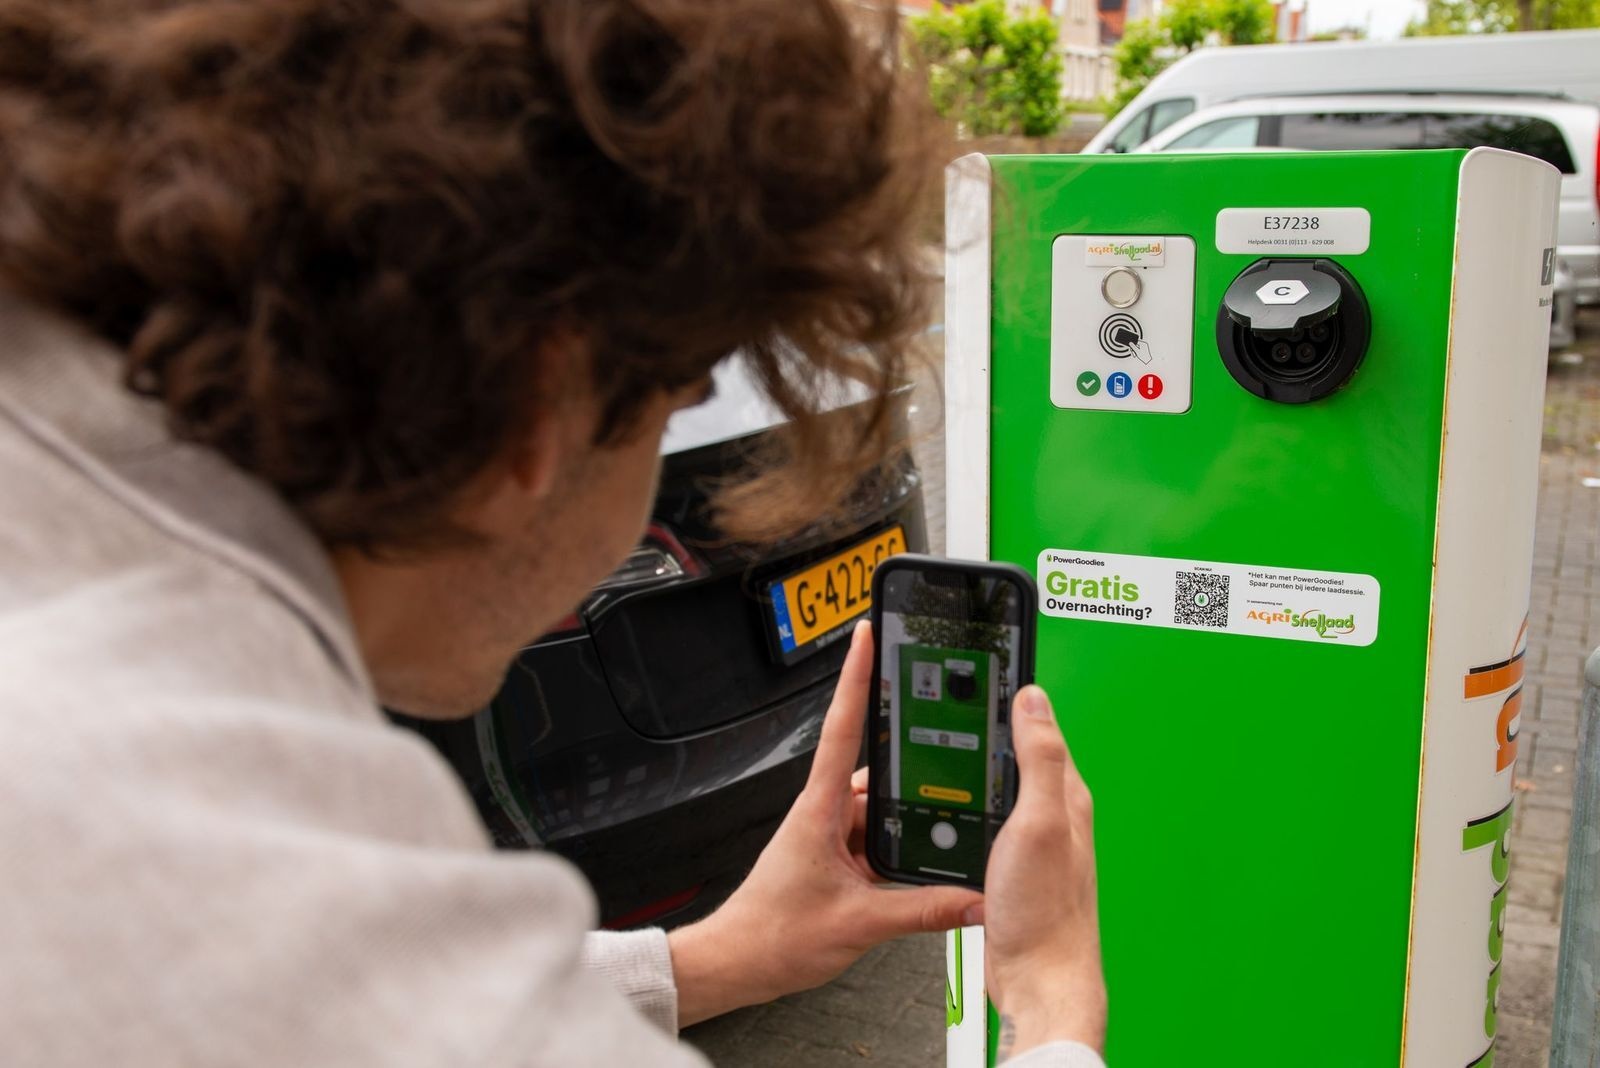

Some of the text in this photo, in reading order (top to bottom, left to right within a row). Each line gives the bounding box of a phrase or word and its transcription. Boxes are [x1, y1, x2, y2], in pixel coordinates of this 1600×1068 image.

[1264, 216, 1320, 230] E37238
[1273, 286, 1291, 297] C
[1053, 555, 1105, 567] PowerGoodies
[1264, 572, 1277, 580] kan
[1278, 574, 1292, 582] met
[1292, 575, 1344, 586] PowerGoodies!
[1045, 571, 1140, 602] Gratis
[1249, 579, 1366, 596] Spaar punten bij iedere laadsessie.
[1046, 598, 1153, 620] Overnachting?
